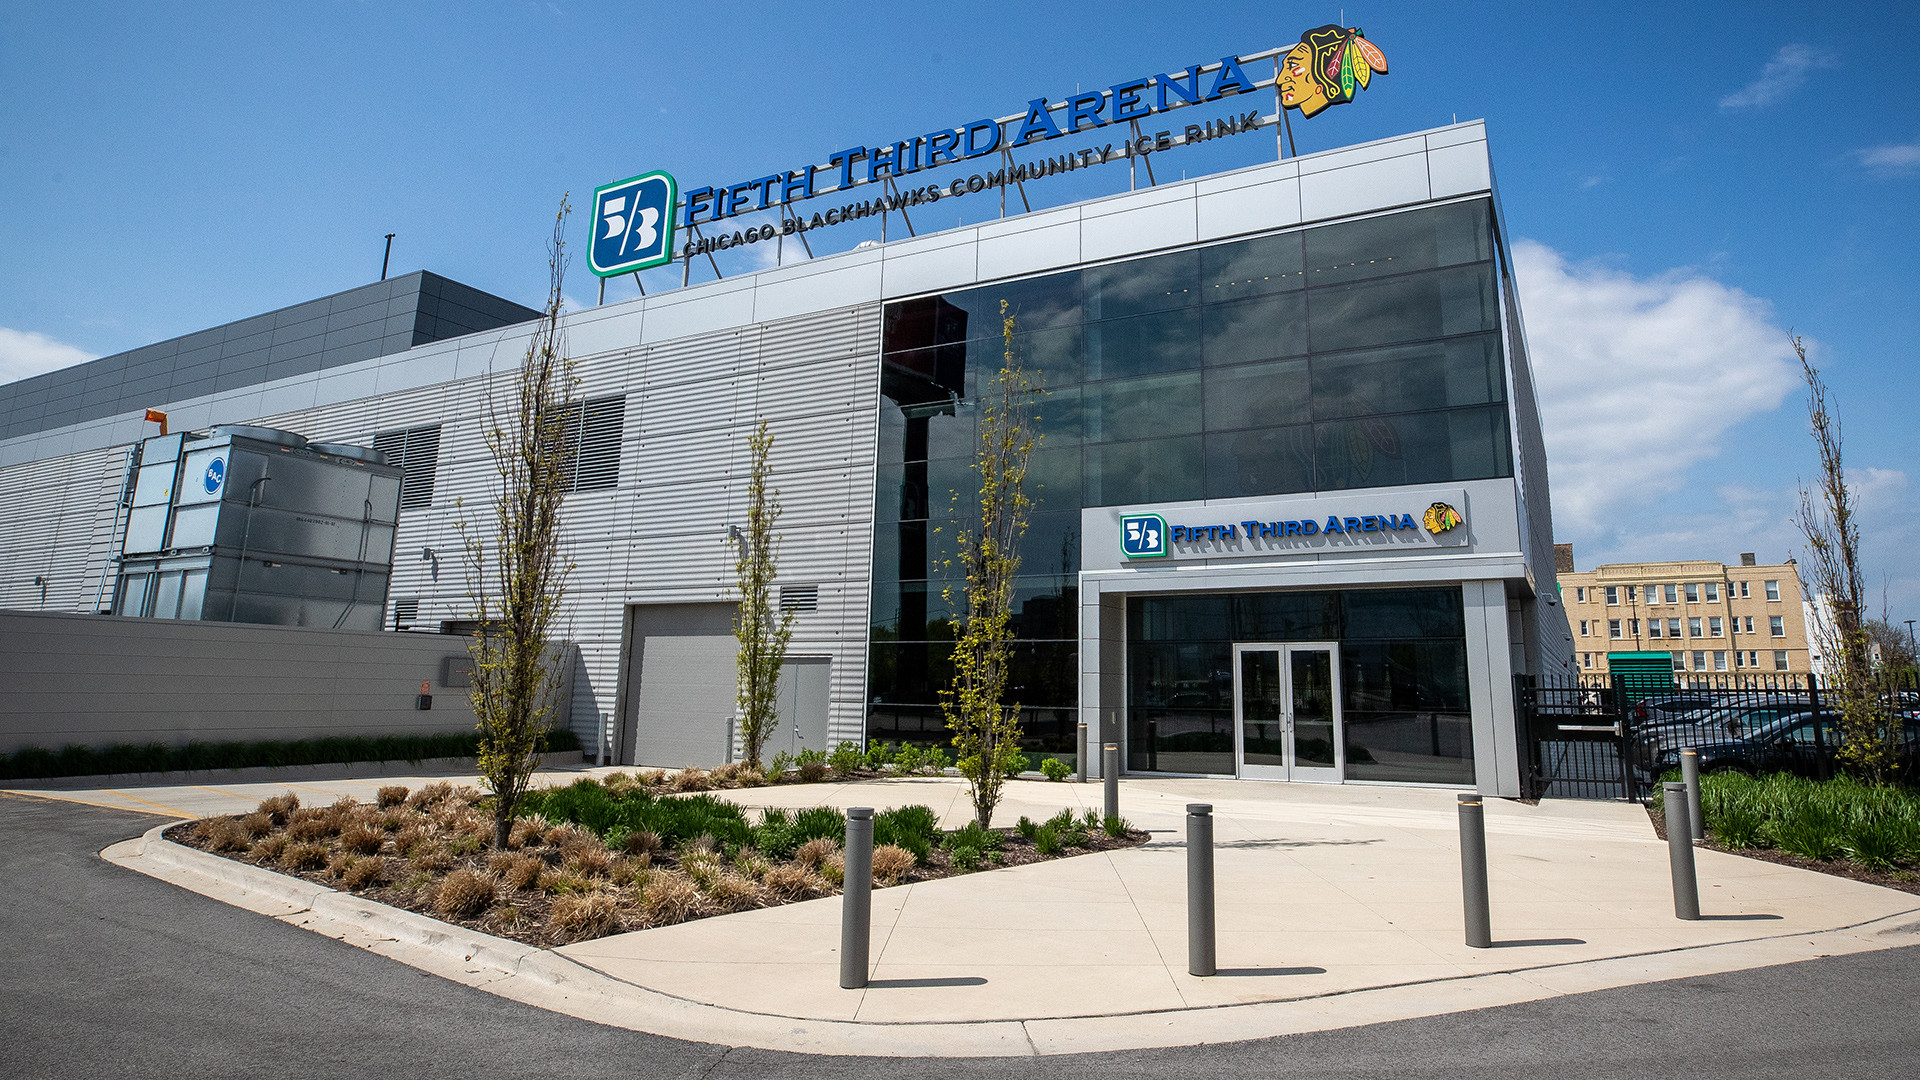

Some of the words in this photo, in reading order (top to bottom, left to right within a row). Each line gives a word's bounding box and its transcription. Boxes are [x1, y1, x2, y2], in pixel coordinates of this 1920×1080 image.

[682, 223, 775, 258] CHICAGO
[783, 184, 940, 236] BLACKHAWKS
[950, 143, 1113, 197] COMMUNITY
[1125, 130, 1172, 158] ICE
[1185, 109, 1260, 143] RINK
[683, 165, 817, 227] FIFTH
[829, 119, 1001, 191] THIRD
[1013, 55, 1258, 146] ARENA
[208, 469, 221, 483] BAC
[1170, 523, 1236, 543] FIFTH
[1241, 519, 1318, 539] THIRD
[1323, 513, 1418, 535] ARENA
